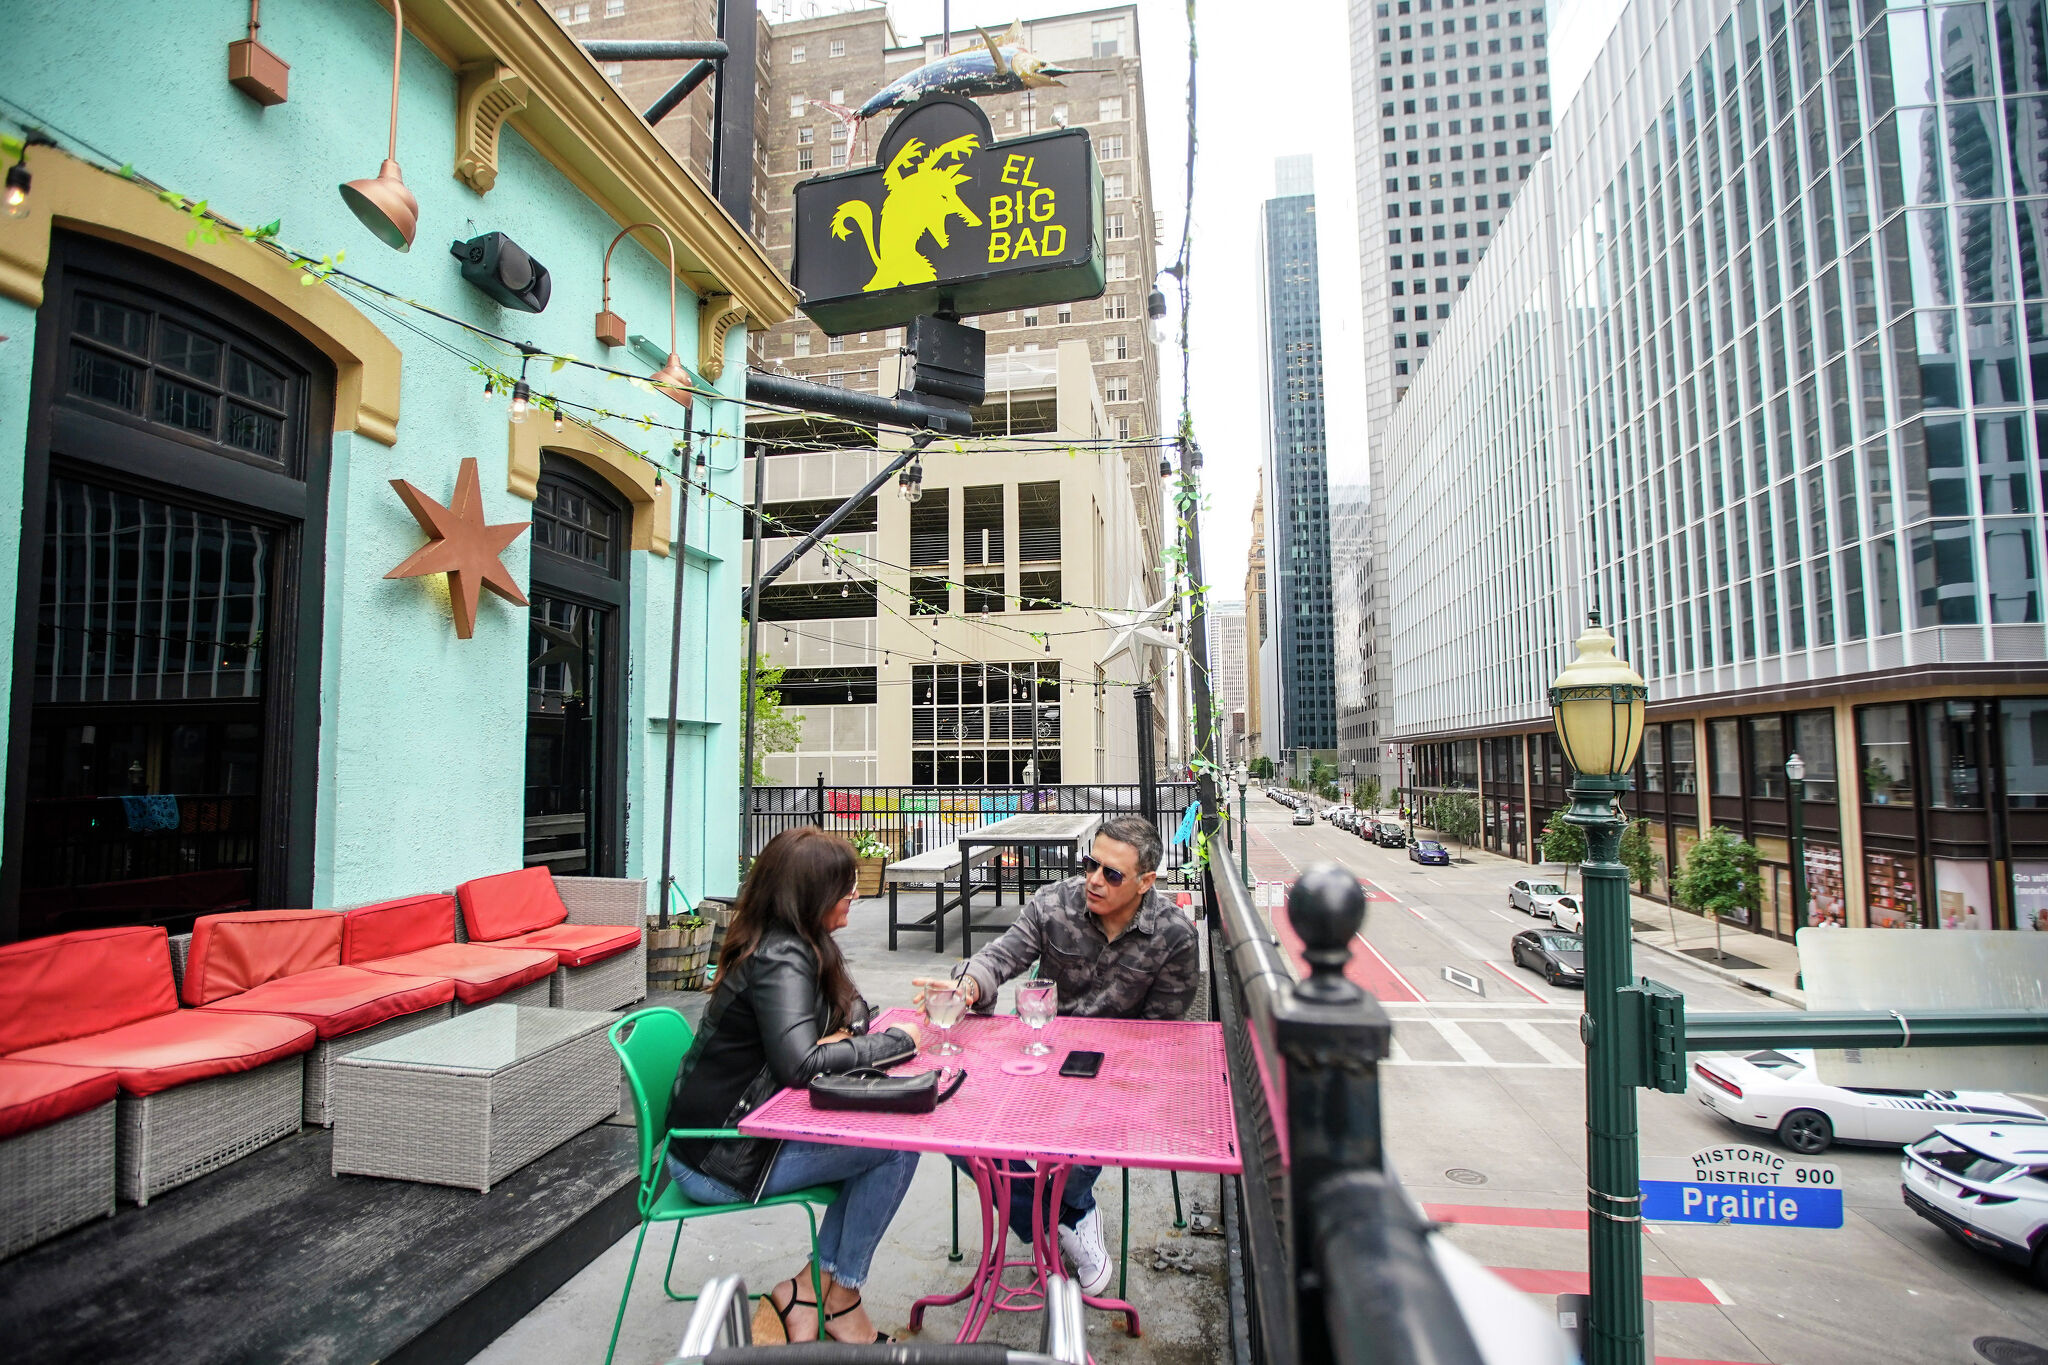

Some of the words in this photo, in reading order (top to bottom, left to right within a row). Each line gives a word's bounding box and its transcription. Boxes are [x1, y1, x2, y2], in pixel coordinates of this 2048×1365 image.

[1001, 153, 1039, 188] EL
[989, 187, 1055, 230] BIG
[987, 224, 1067, 263] BAD
[2013, 873, 2030, 882] Go
[1692, 1149, 1785, 1170] HISTORIC
[1697, 1169, 1780, 1185] DISTRICT
[1796, 1168, 1834, 1185] 900
[1682, 1188, 1798, 1221] Prairie
